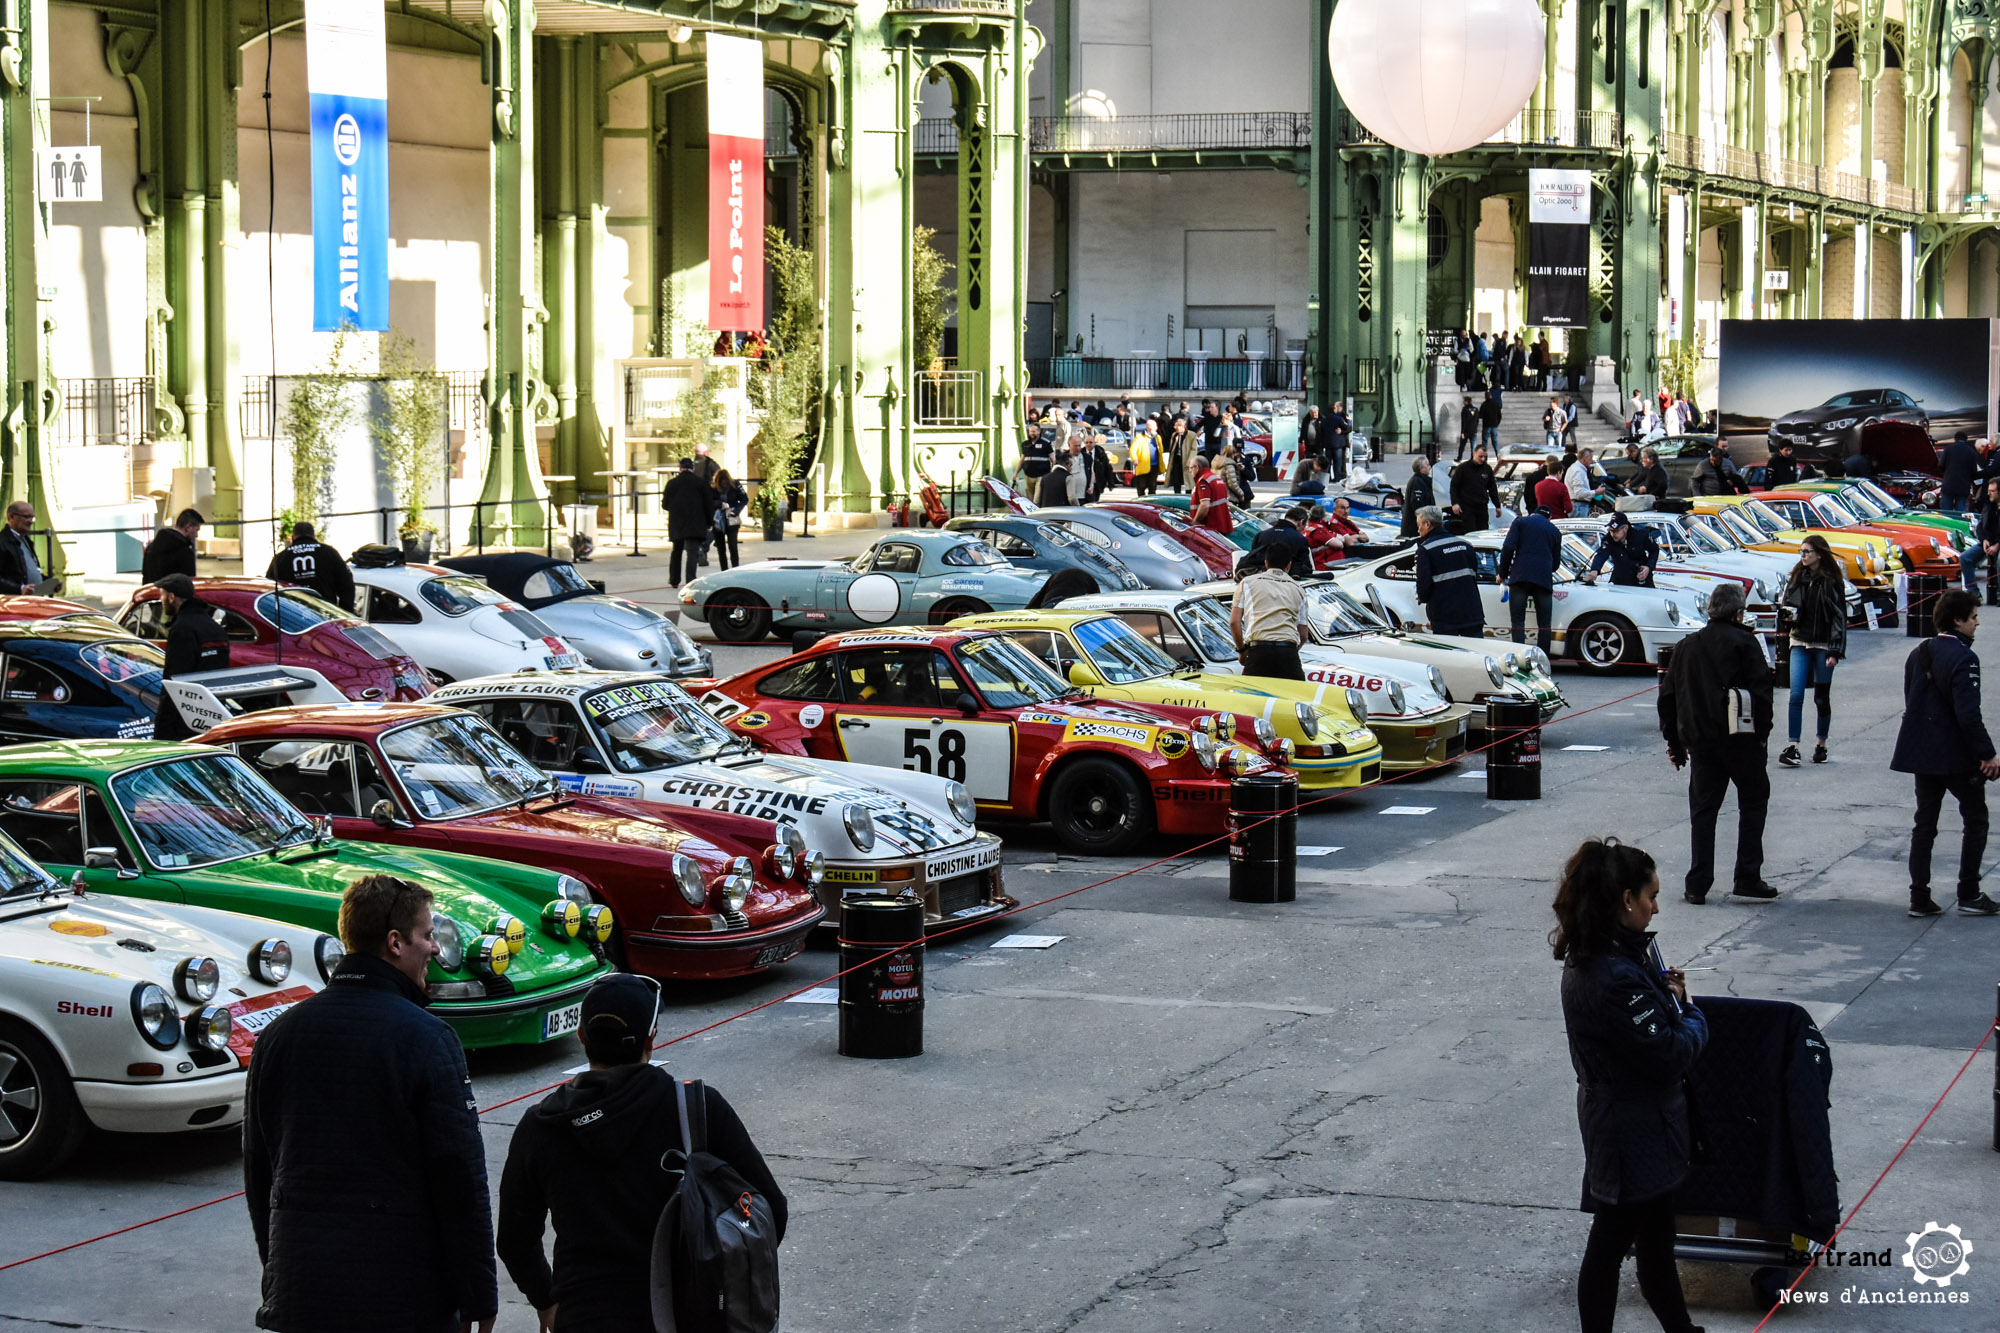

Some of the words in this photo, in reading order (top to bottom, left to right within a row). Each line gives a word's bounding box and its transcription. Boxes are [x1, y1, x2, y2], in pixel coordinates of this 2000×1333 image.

[728, 159, 743, 250] Point
[1538, 197, 1555, 205] Optic
[340, 174, 359, 313] Allianz
[730, 255, 742, 293] Le
[1529, 266, 1551, 275] ALAIN
[1555, 267, 1587, 276] FIGARET
[842, 635, 934, 643] GOODYEAR
[1304, 670, 1383, 692] diale
[185, 689, 199, 701] KIT
[433, 684, 518, 699] CHRISTINE
[520, 683, 579, 697] LAURE
[587, 694, 611, 713] BP
[612, 687, 634, 707] BP
[635, 685, 656, 701] BP
[181, 702, 223, 720] POLYESTER
[607, 698, 663, 720] PORSCHE
[1032, 713, 1064, 722] GTS
[1097, 725, 1147, 740] SACHS
[903, 727, 967, 785] 58
[662, 780, 829, 815] CHRISTINE
[1154, 786, 1223, 801] Shell
[874, 810, 950, 851] BP
[927, 854, 976, 878] CHRISTINE
[977, 848, 1000, 868] LAURE
[824, 872, 873, 881] CHELIN
[888, 964, 914, 973] MOTUL
[880, 987, 919, 1000] MOTUL
[57, 1000, 113, 1018] Shell
